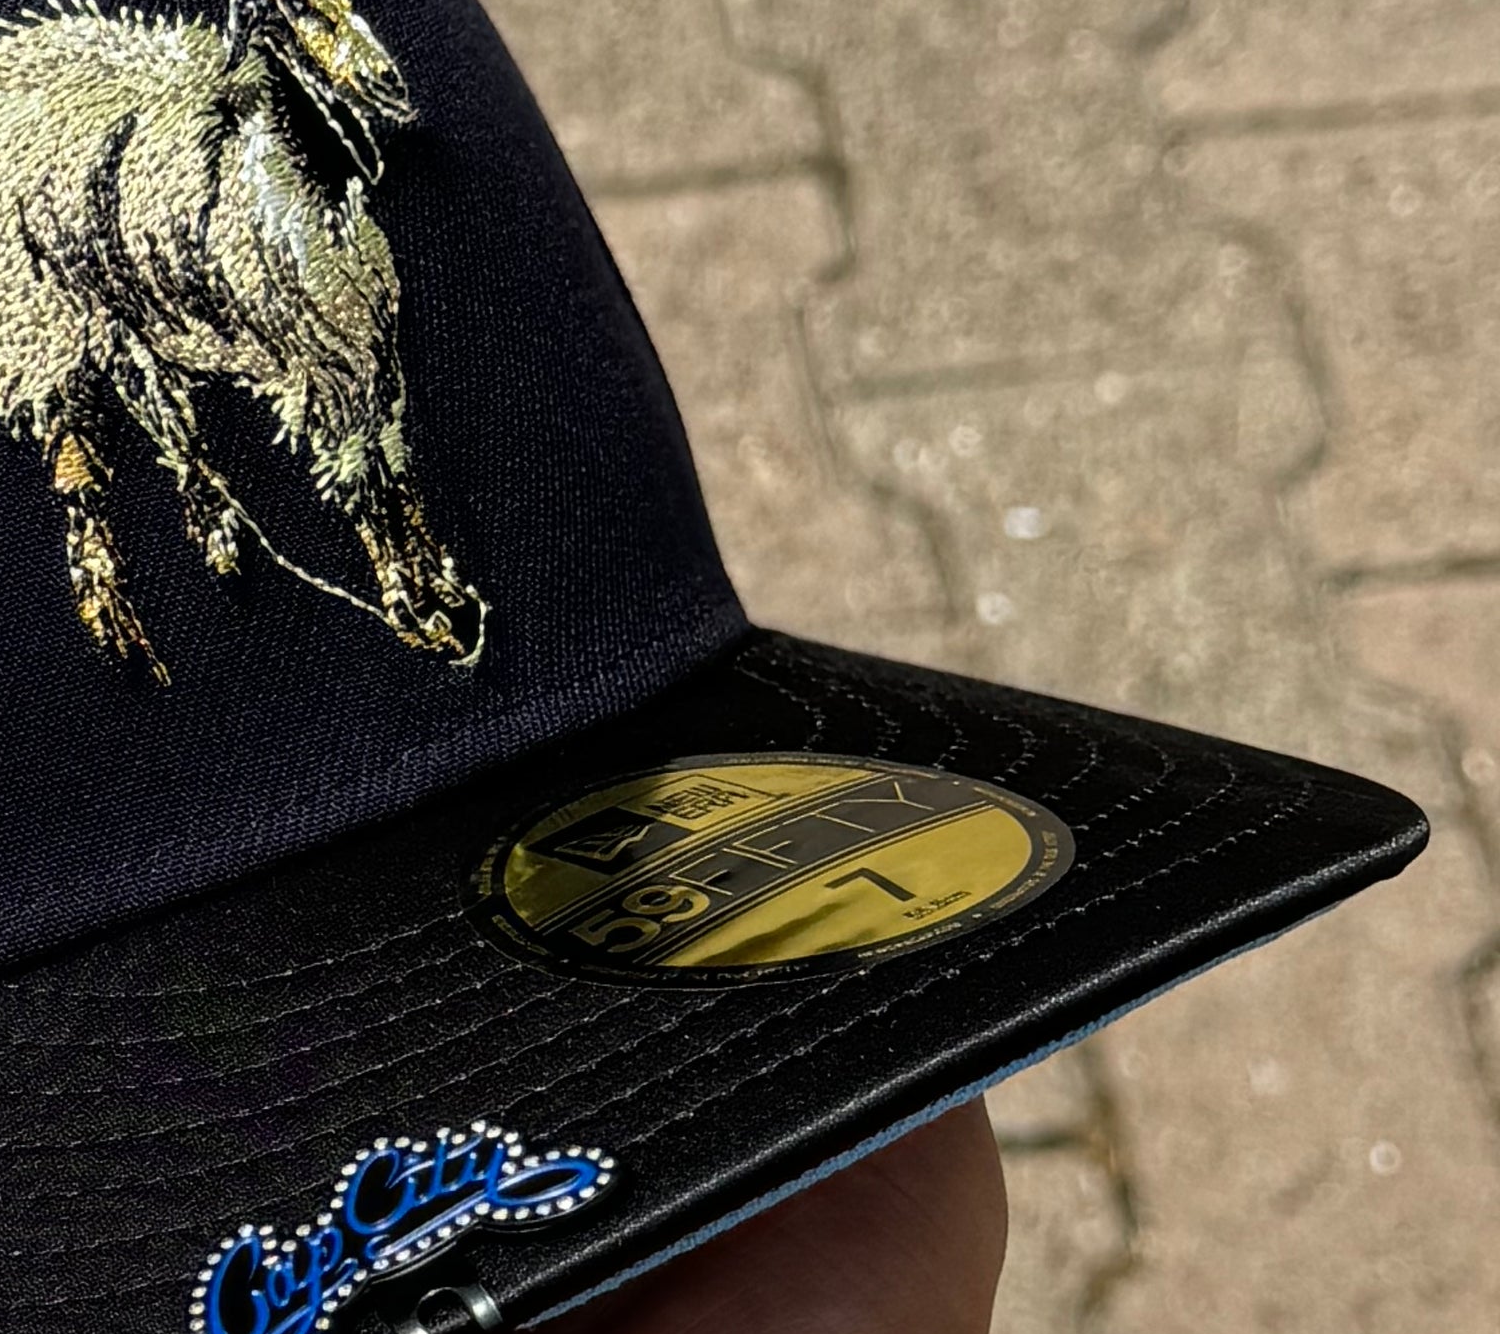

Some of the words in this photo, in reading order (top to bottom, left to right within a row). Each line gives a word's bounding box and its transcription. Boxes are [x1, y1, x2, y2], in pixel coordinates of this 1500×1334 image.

[647, 782, 722, 814] NEW
[674, 791, 750, 821] ERA
[568, 780, 935, 954] 59FIFTY
[823, 867, 917, 903] 7
[345, 1132, 602, 1261] City
